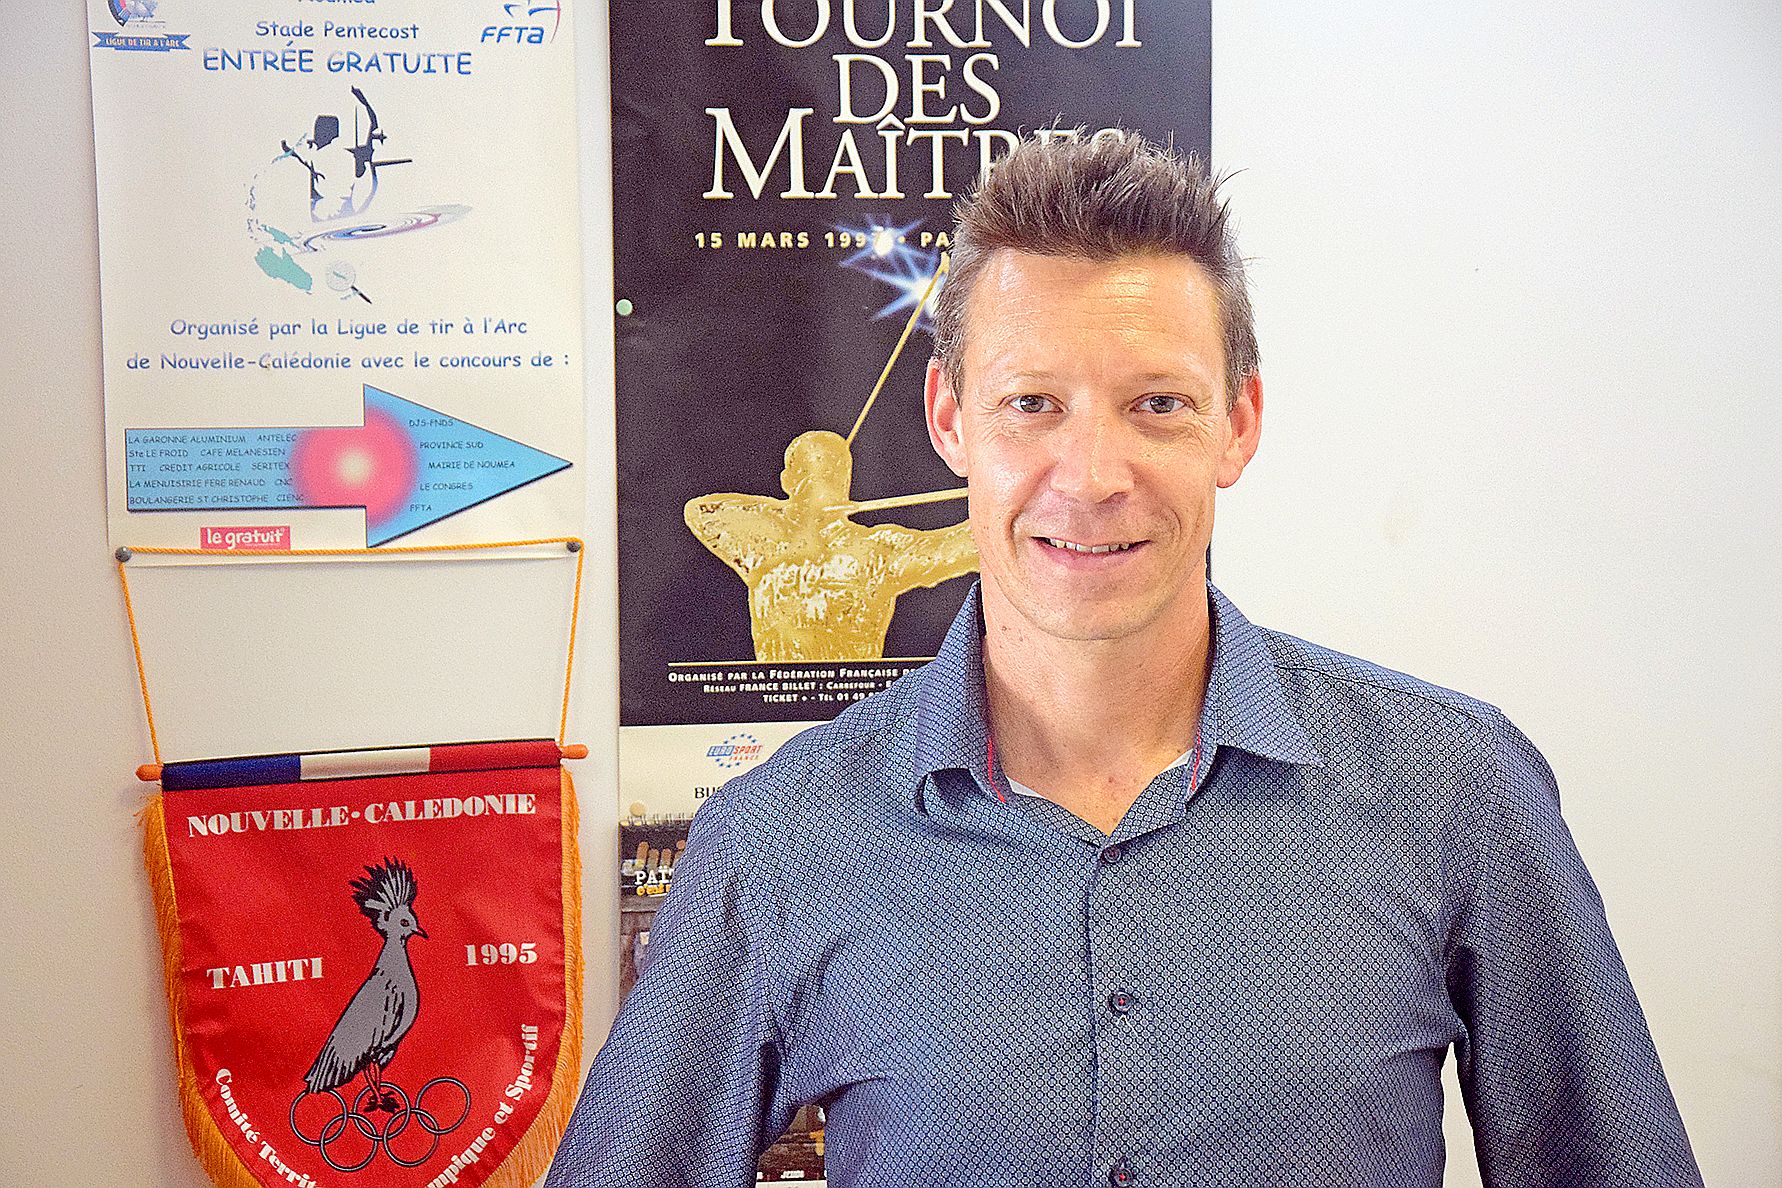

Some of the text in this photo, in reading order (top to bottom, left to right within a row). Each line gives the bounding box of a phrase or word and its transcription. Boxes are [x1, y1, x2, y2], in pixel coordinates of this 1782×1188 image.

[255, 20, 419, 39] Stade Pentecost
[203, 41, 471, 75] ENTRÉE GRATUITE
[832, 52, 1001, 125] DES
[702, 107, 1125, 200] MAÎTR
[694, 232, 723, 248] 15
[737, 232, 810, 248] MARS
[170, 317, 528, 340] Organisé par la Ligue de tir à l'Arc
[126, 354, 151, 370] de
[160, 351, 352, 370] Nouvelle-Calédonie
[361, 355, 404, 368] avec
[414, 352, 430, 368] le
[439, 354, 522, 368] concours
[530, 352, 553, 367] de
[128, 436, 140, 444] LA
[190, 435, 246, 443] ALUMINIUM
[159, 449, 189, 458] FROID
[159, 464, 193, 472] CREDIT
[196, 463, 240, 471] AGRICOLE
[428, 461, 515, 469] MAIRIE DE NOUMEA
[129, 481, 141, 489] LA
[420, 483, 430, 491] LE
[206, 528, 284, 550] le gratuit
[739, 682, 779, 692] FRANCE
[781, 681, 816, 690] BILLET
[763, 694, 798, 702] TICKET
[463, 942, 538, 967] 1995
[206, 957, 324, 990] TAHITI
[215, 1068, 261, 1144] Comité
[493, 1101, 514, 1125] et
[504, 1023, 539, 1101] Sportif
